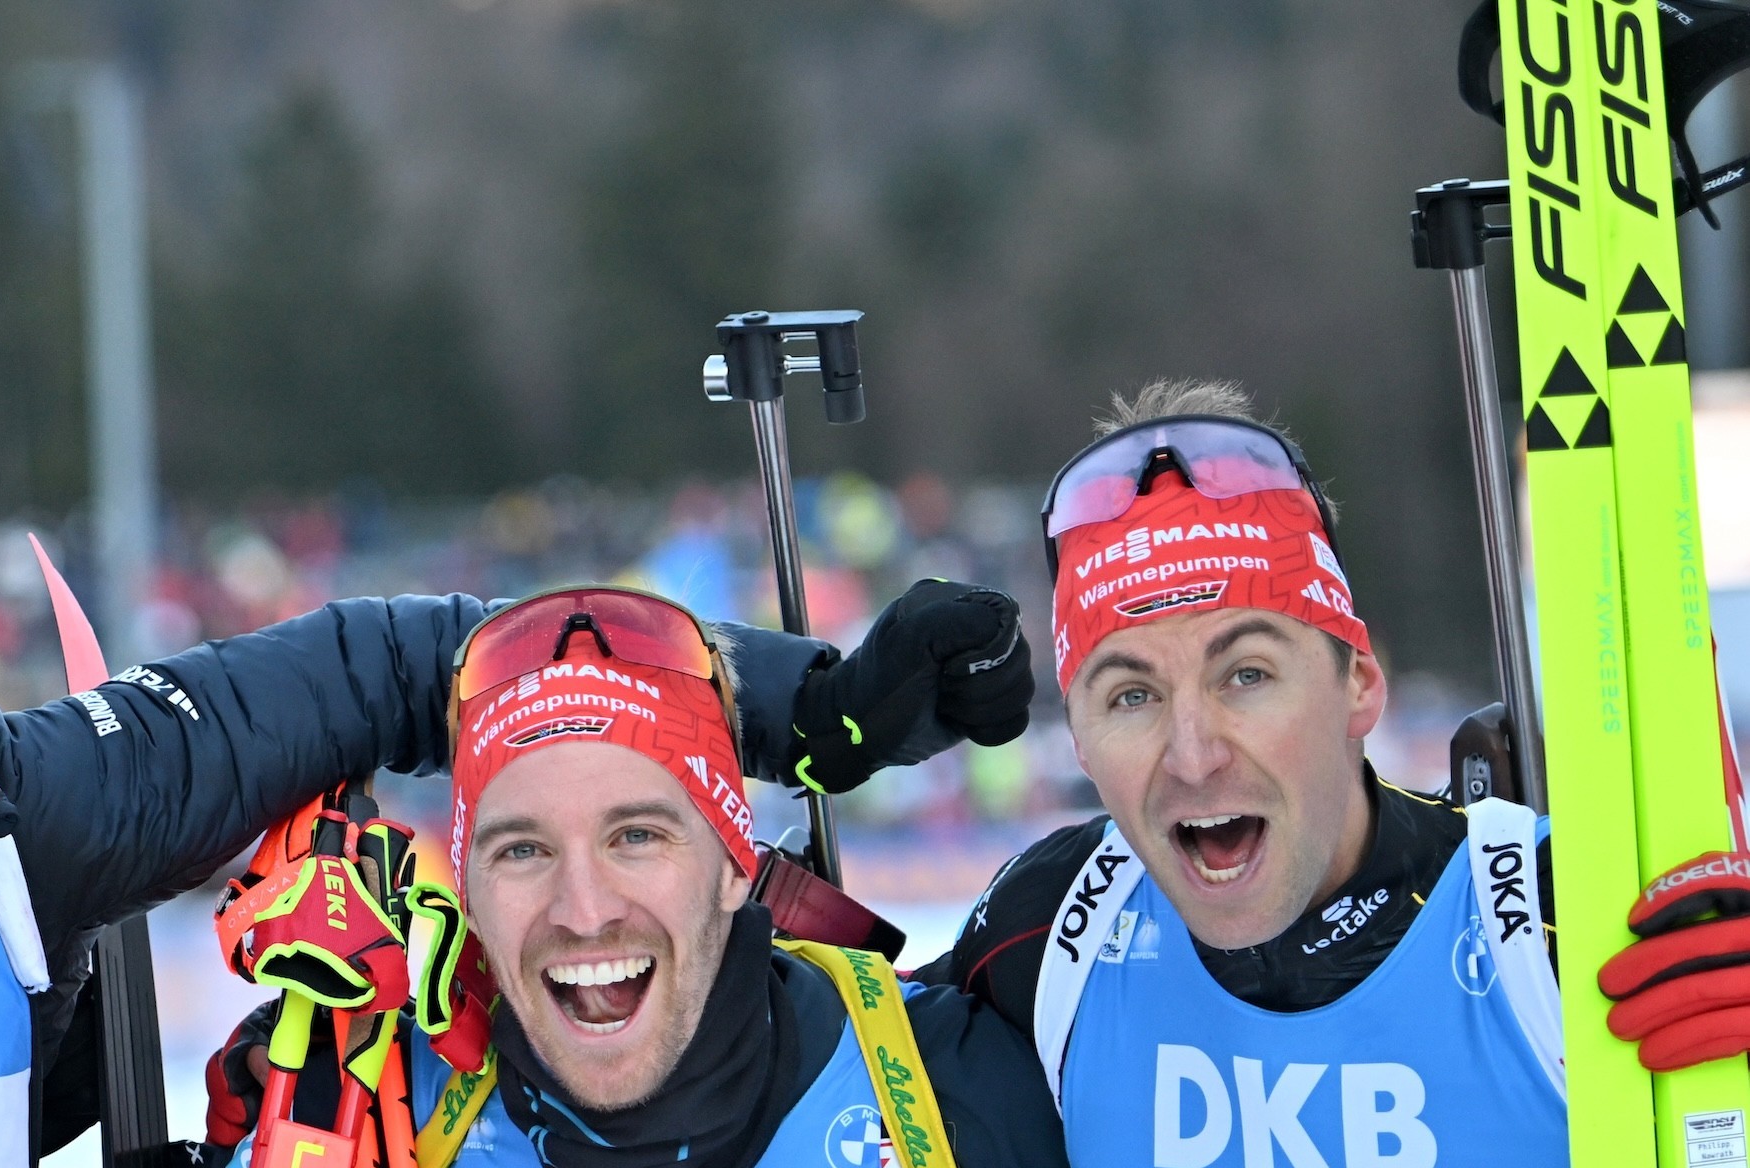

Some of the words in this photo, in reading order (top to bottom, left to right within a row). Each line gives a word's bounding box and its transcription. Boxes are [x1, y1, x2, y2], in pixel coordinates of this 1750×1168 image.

[1515, 0, 1588, 302] FISC
[1078, 555, 1270, 610] Wärmepumpen
[472, 692, 657, 757] Wärmepumpen
[320, 859, 348, 932] LEKI
[1056, 853, 1131, 964] JOKA
[1481, 842, 1531, 945] JOKA
